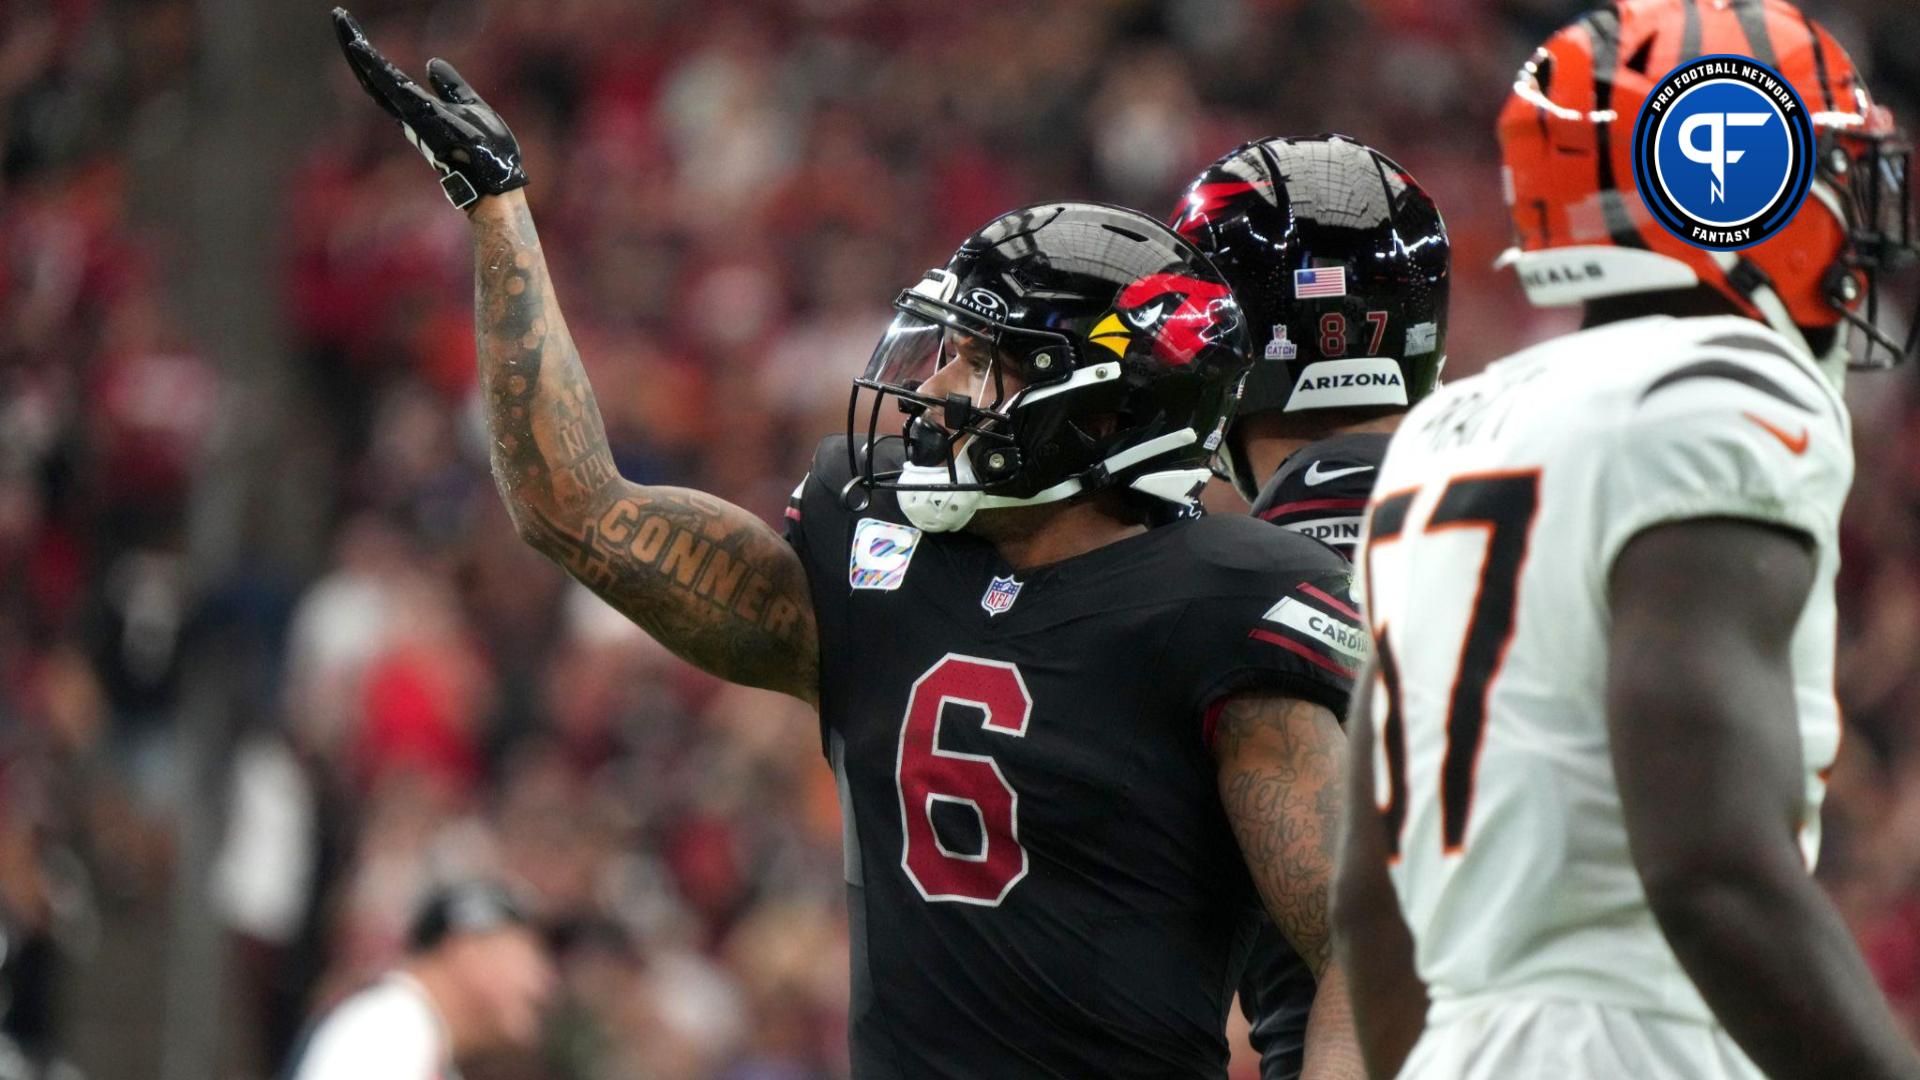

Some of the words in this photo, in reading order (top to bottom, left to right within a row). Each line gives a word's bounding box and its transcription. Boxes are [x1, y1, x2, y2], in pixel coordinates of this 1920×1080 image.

[961, 298, 1004, 320] OAKLEY
[1299, 372, 1401, 392] ARIZONA
[600, 498, 799, 639] CONNER
[987, 590, 1009, 608] NFL
[895, 652, 1033, 907] 6
